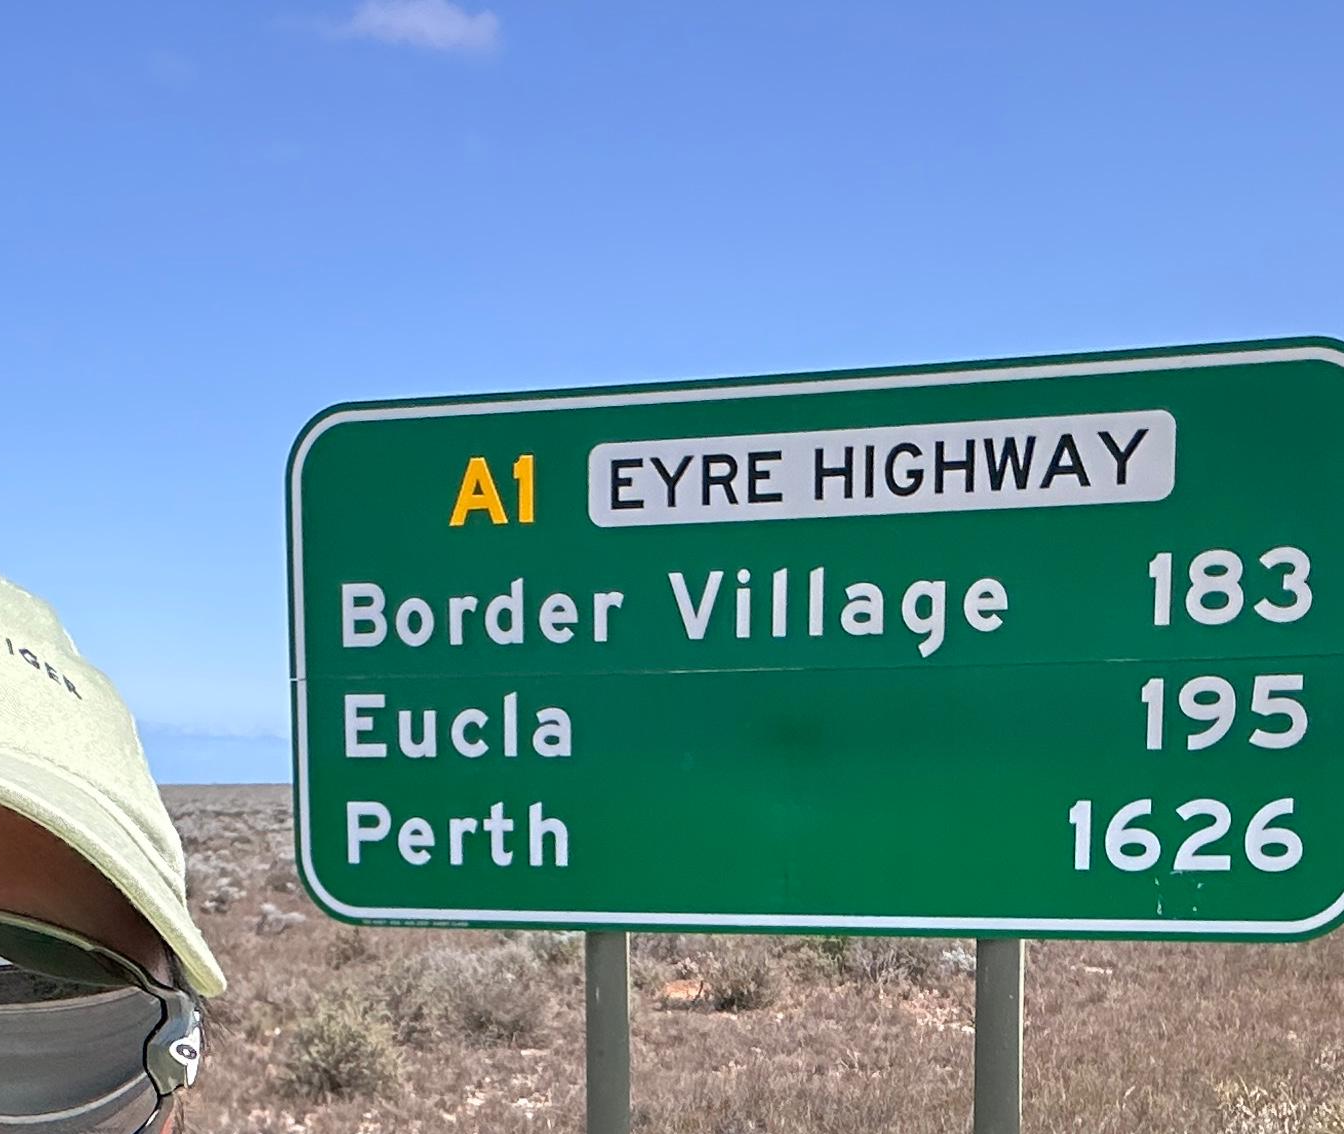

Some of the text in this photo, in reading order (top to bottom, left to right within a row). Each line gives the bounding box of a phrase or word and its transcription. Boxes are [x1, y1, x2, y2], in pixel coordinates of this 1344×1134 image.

[449, 454, 535, 527] A1
[610, 429, 1150, 511] EYRE HIGHWAY
[341, 546, 1313, 658] Border Village 183
[344, 674, 1309, 759] Eucla 195
[346, 797, 1304, 874] Perth 1626
